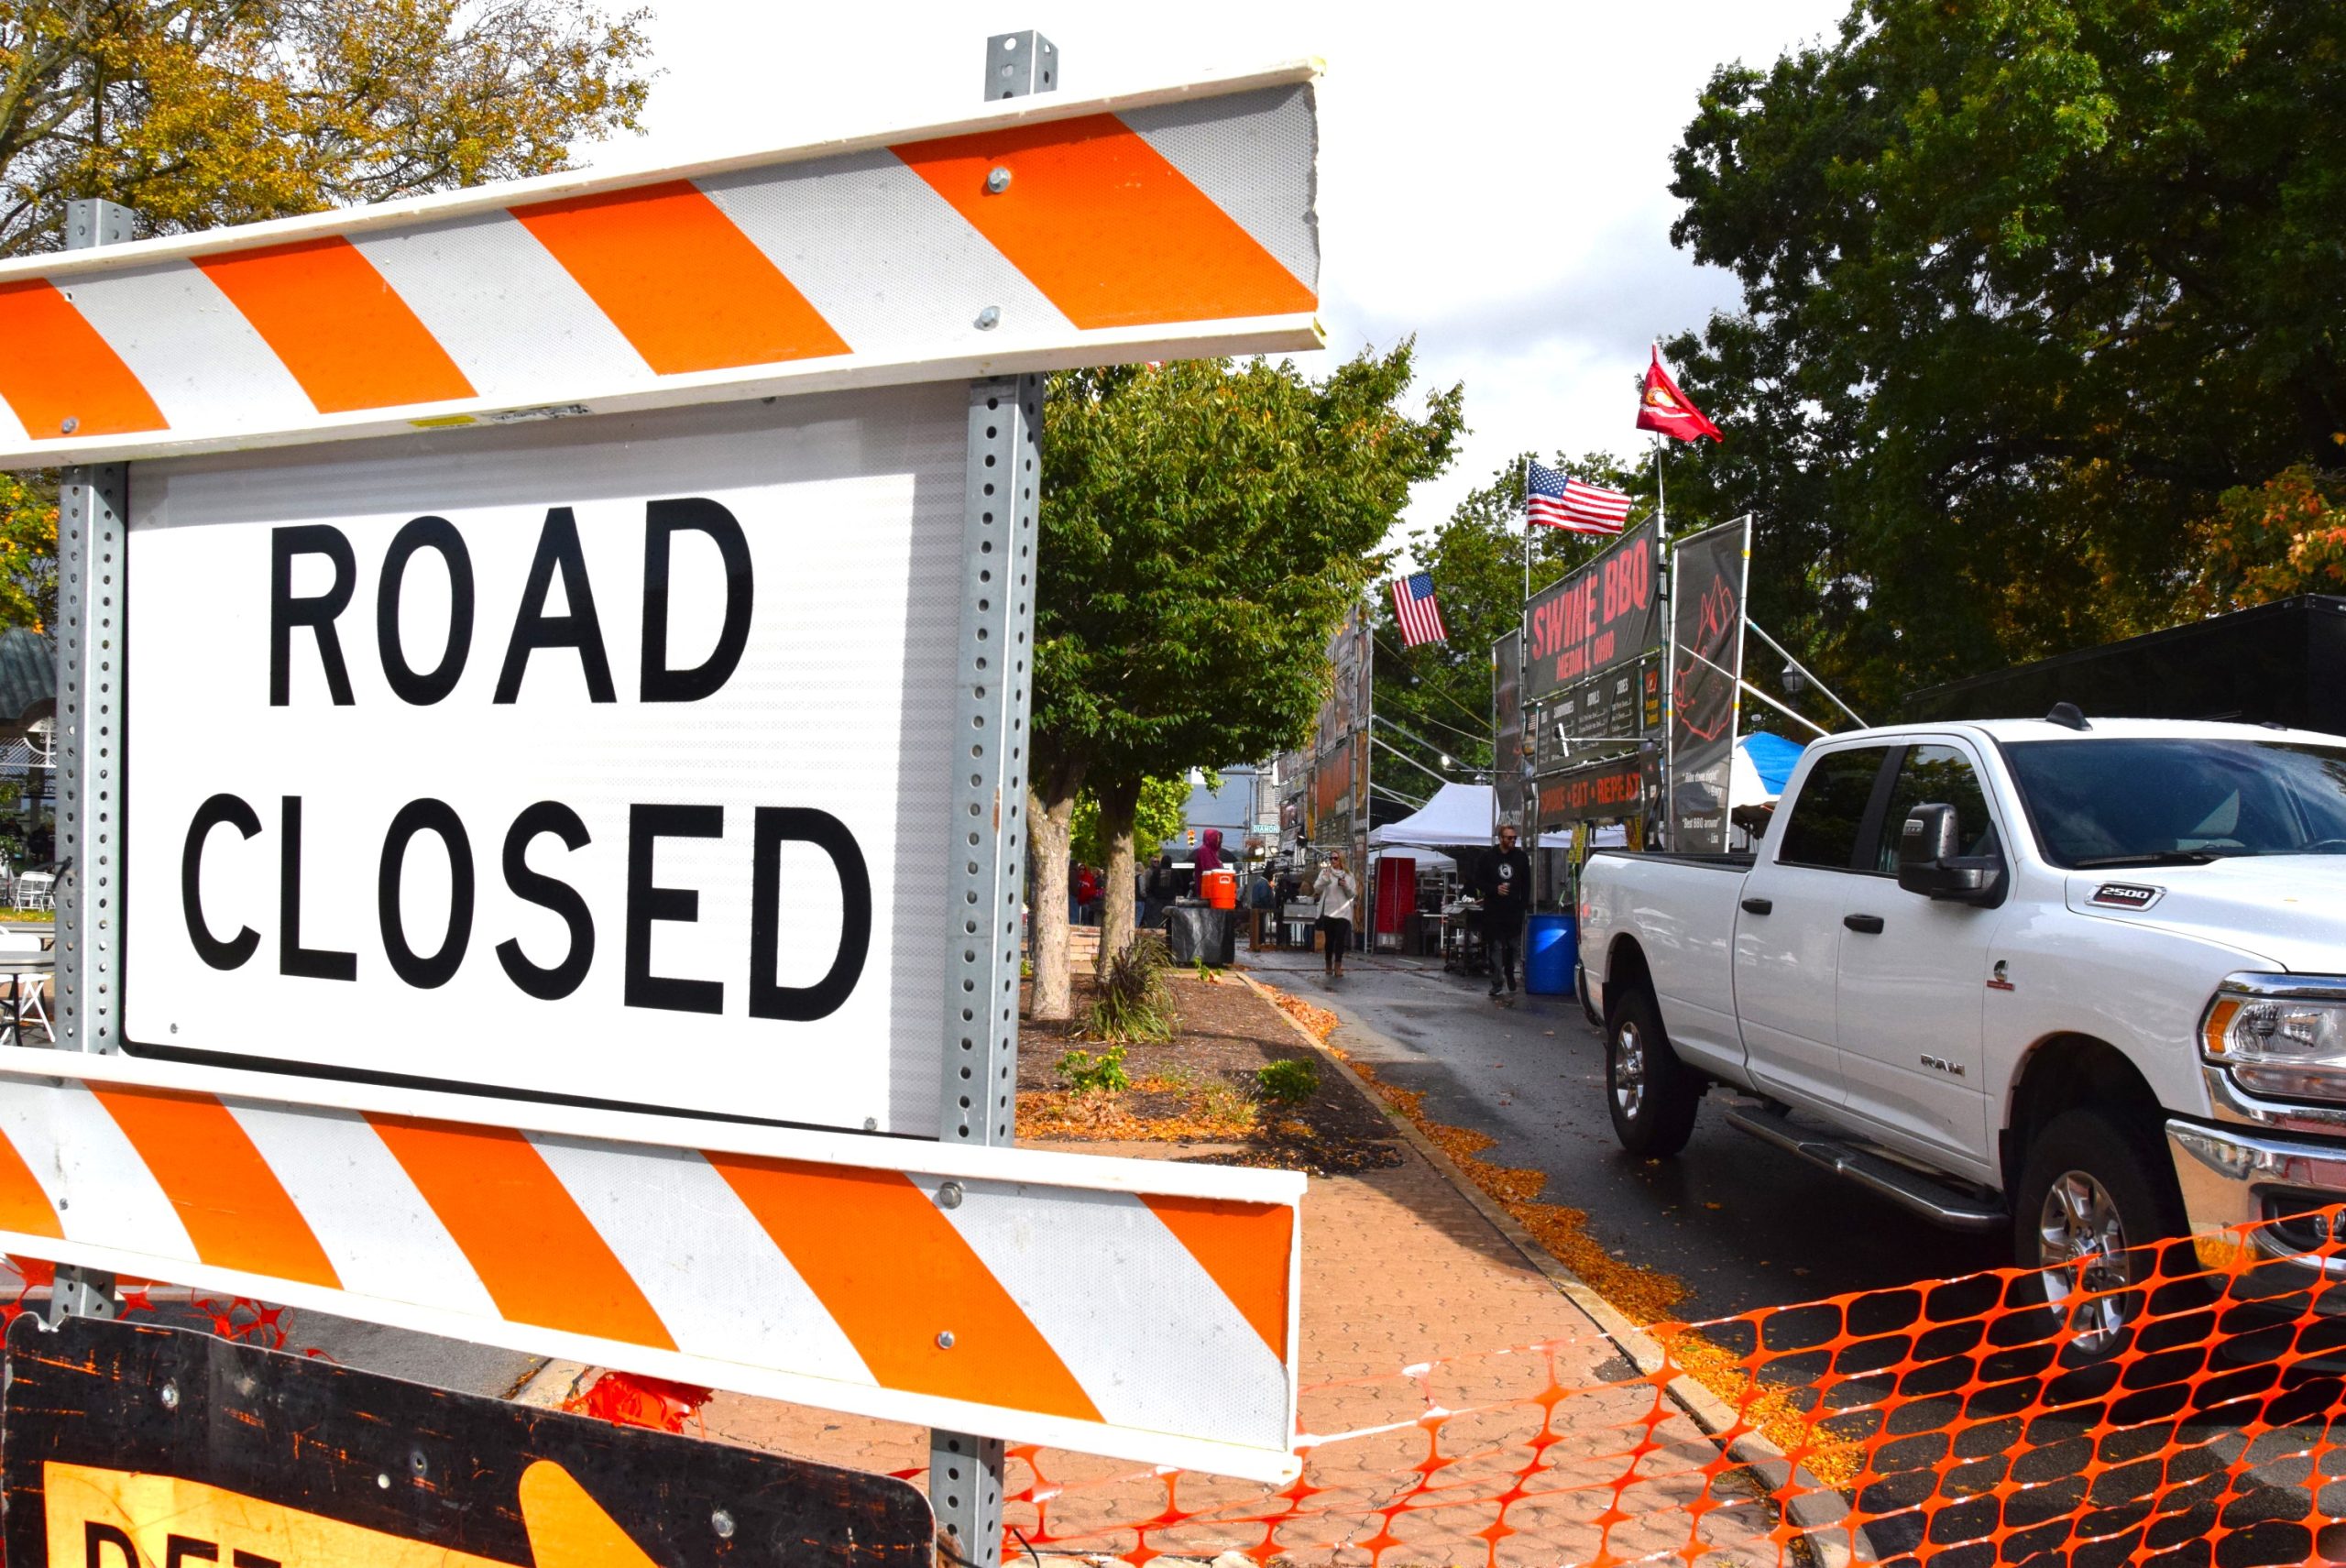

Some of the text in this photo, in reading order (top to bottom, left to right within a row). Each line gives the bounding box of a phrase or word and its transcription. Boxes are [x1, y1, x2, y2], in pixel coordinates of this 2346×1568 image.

[269, 497, 754, 707] ROAD
[1532, 539, 1648, 661] SWINE BBQ
[1594, 630, 1615, 665] OHIO
[1617, 677, 1628, 696] SIDES
[1572, 780, 1589, 808] EAT
[1596, 772, 1641, 805] REPEAT
[181, 793, 872, 1022] CLOSED
[2101, 886, 2150, 899] 2500
[1920, 1052, 1966, 1079] RAM
